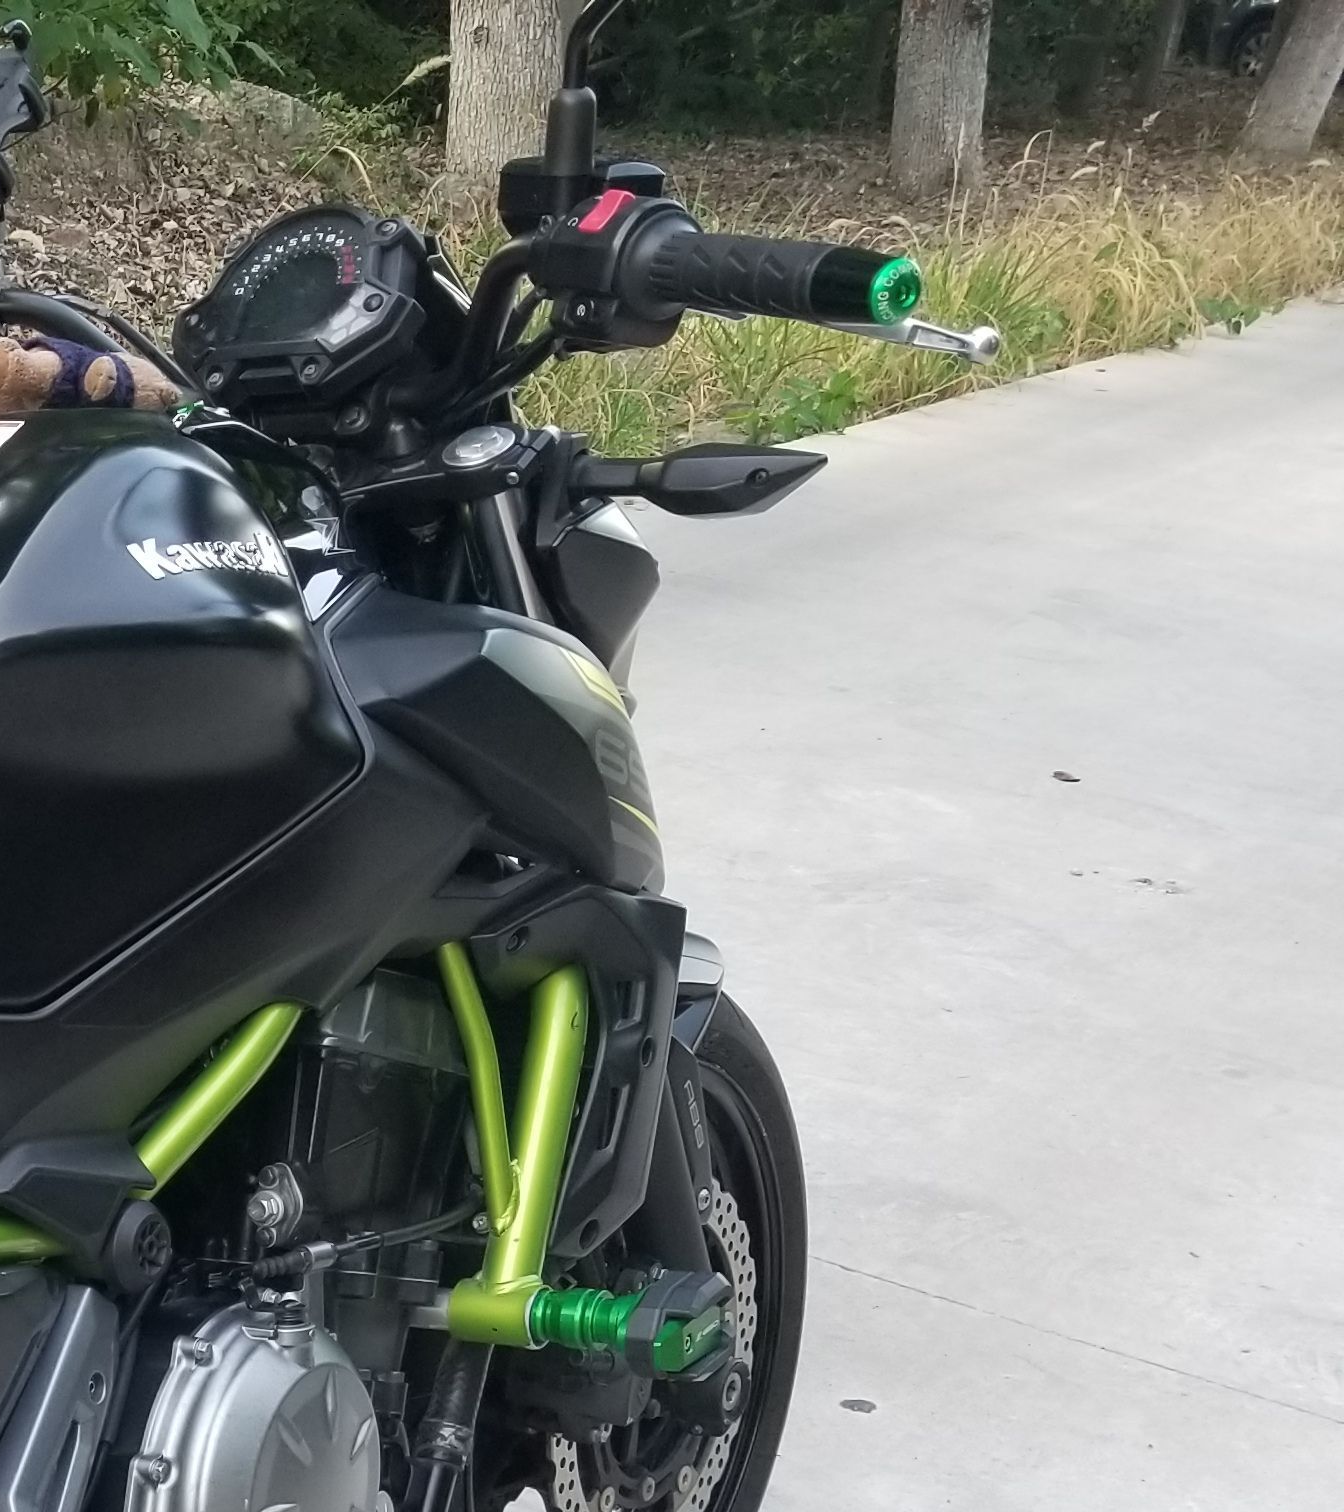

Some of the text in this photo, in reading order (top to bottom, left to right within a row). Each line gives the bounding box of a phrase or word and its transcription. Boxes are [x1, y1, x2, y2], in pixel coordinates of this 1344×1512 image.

[235, 232, 345, 295] 0 1 2 3 4 5 6 7 8 9
